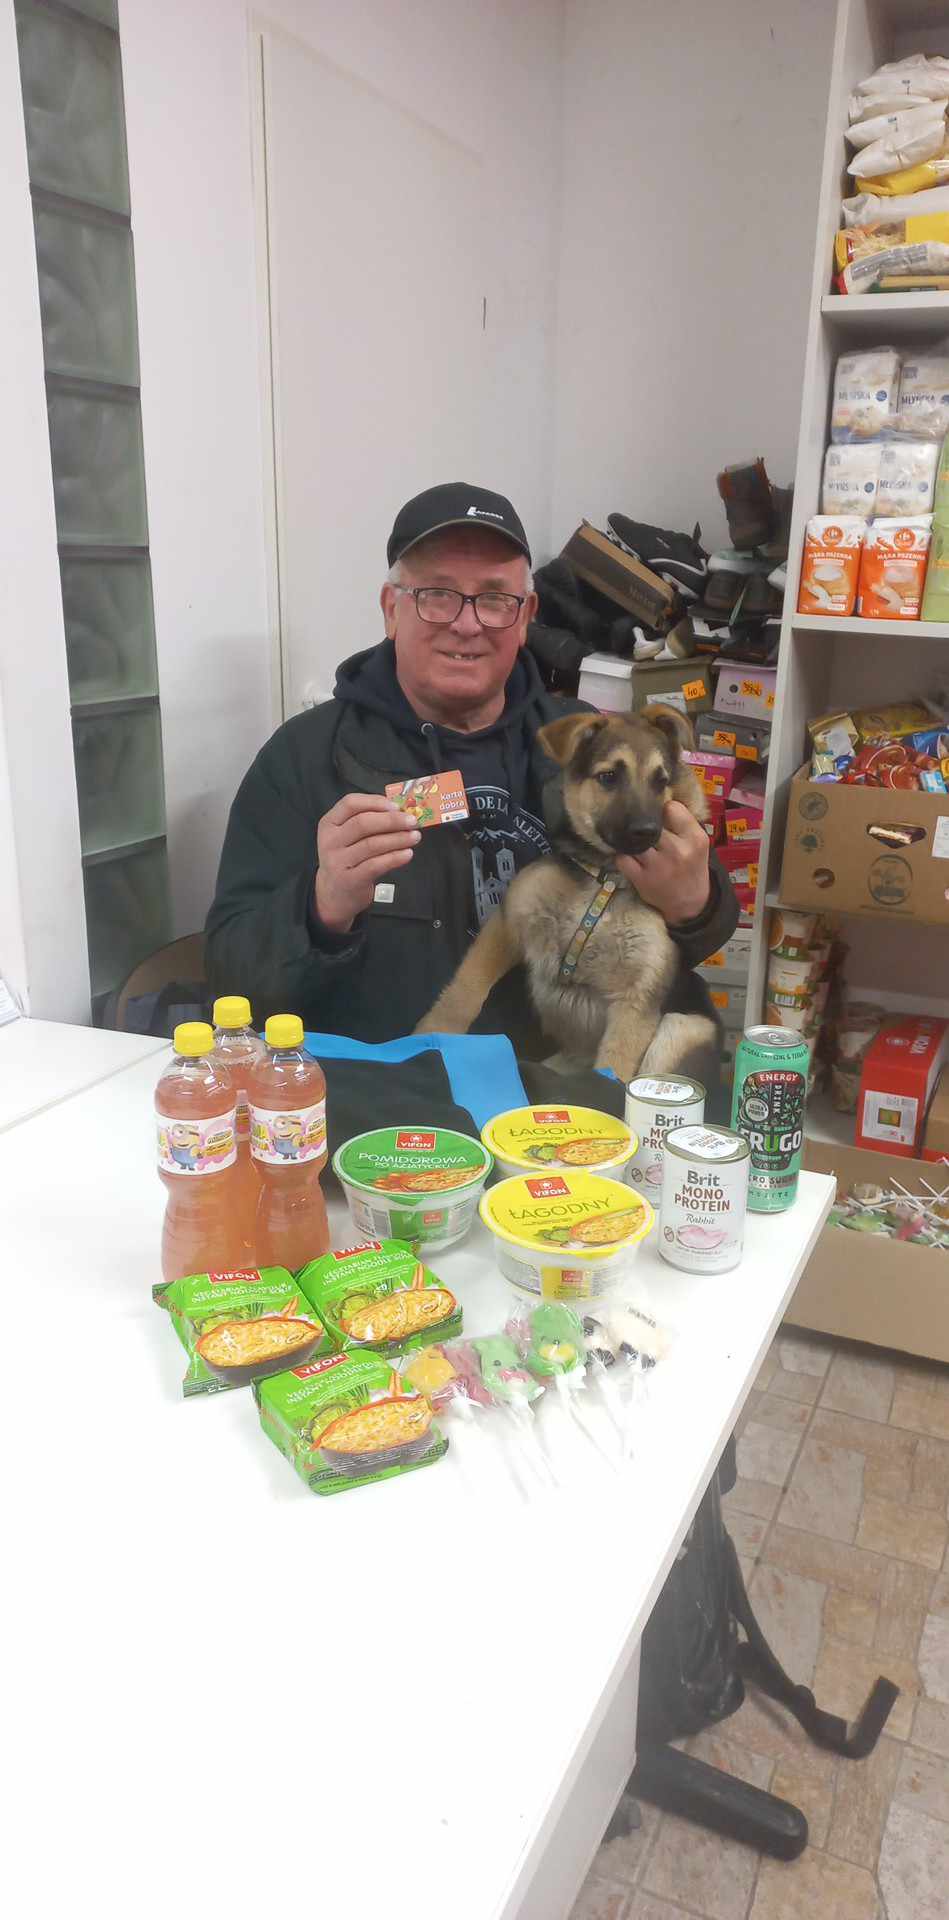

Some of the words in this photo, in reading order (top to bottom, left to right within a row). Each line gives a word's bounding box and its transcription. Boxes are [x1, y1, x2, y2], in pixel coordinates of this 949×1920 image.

[475, 796, 495, 810] DE
[760, 1073, 798, 1081] ENERGY
[773, 1084, 782, 1114] DRINK
[655, 1113, 685, 1128] Brit
[508, 1127, 604, 1138] ŁAGODNY
[358, 1152, 467, 1165] POMIDOROWA
[687, 1169, 720, 1187] Brit
[534, 1187, 568, 1198] VIFON
[682, 1184, 724, 1200] MONO
[508, 1197, 611, 1220] ŁAGODNY
[674, 1193, 730, 1212] PROTEIN
[686, 1213, 716, 1225] Rabbit
[213, 1271, 257, 1280] VIFON
[303, 1354, 345, 1375] VIFON
